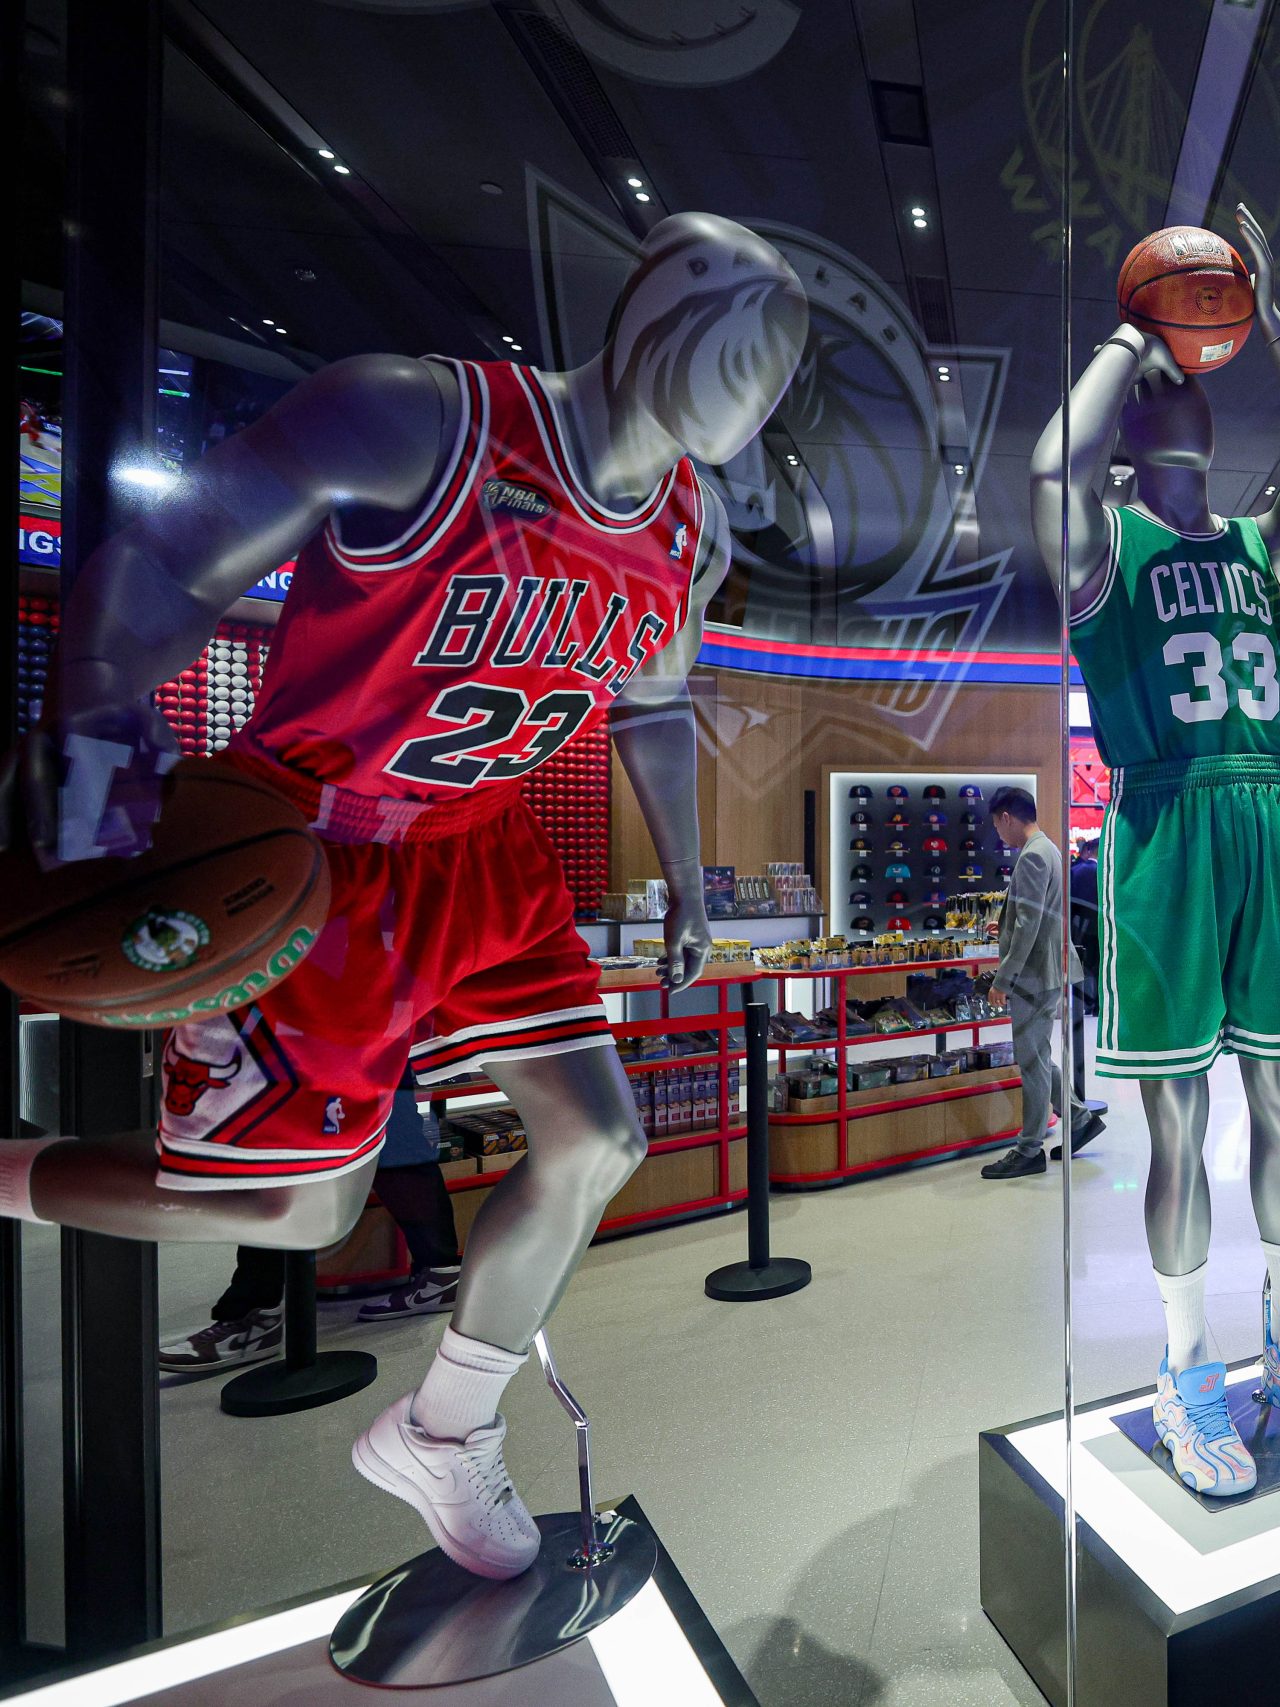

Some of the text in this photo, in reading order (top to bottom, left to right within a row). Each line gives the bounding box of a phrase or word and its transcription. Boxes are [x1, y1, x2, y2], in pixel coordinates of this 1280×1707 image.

[497, 495, 546, 513] Finals
[502, 486, 537, 502] NBA
[1150, 561, 1273, 626] CELTICS
[412, 573, 667, 697] BULLS
[1162, 631, 1280, 723] 33
[382, 680, 597, 788] 23
